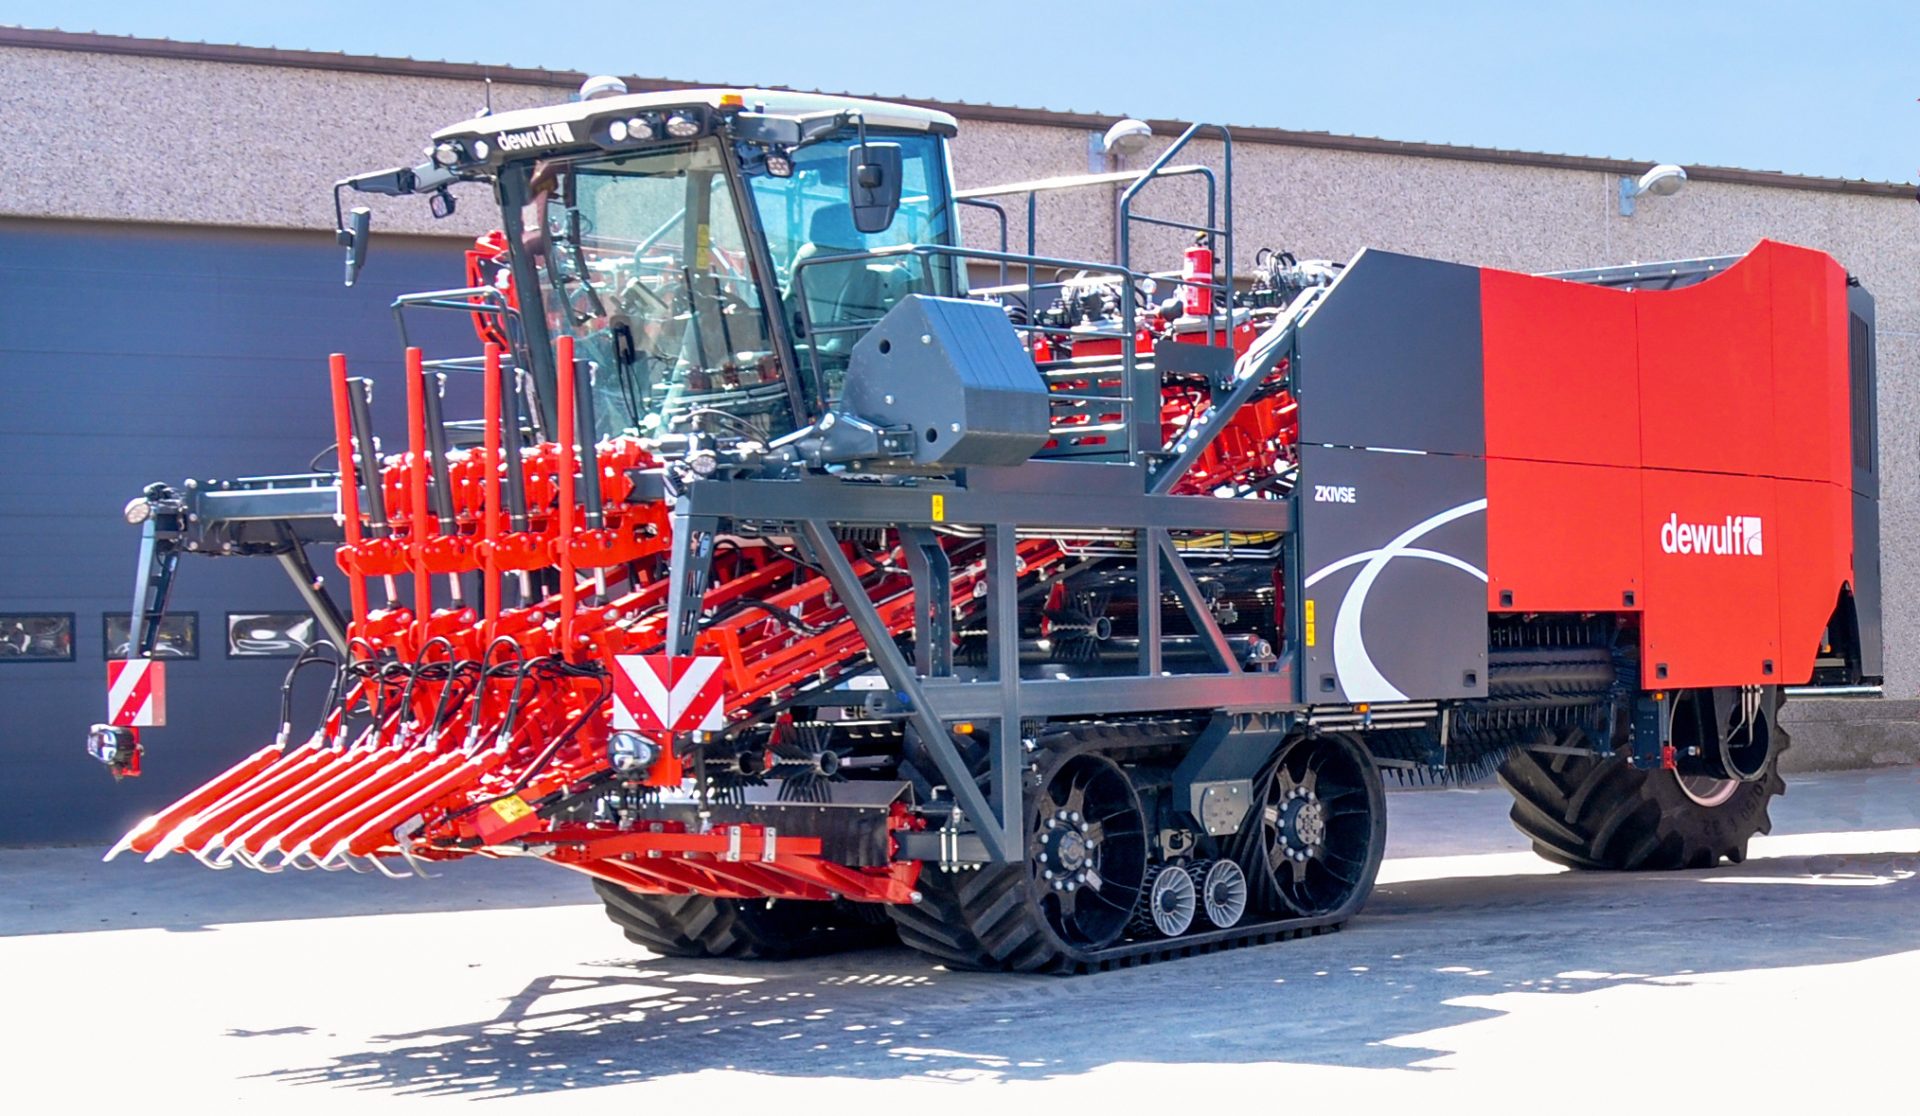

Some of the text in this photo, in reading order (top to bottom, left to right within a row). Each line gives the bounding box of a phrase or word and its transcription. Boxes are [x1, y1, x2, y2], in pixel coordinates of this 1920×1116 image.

[497, 124, 557, 151] dewulf
[1314, 485, 1357, 503] ZKIVSE
[1661, 512, 1743, 555] dewulf
